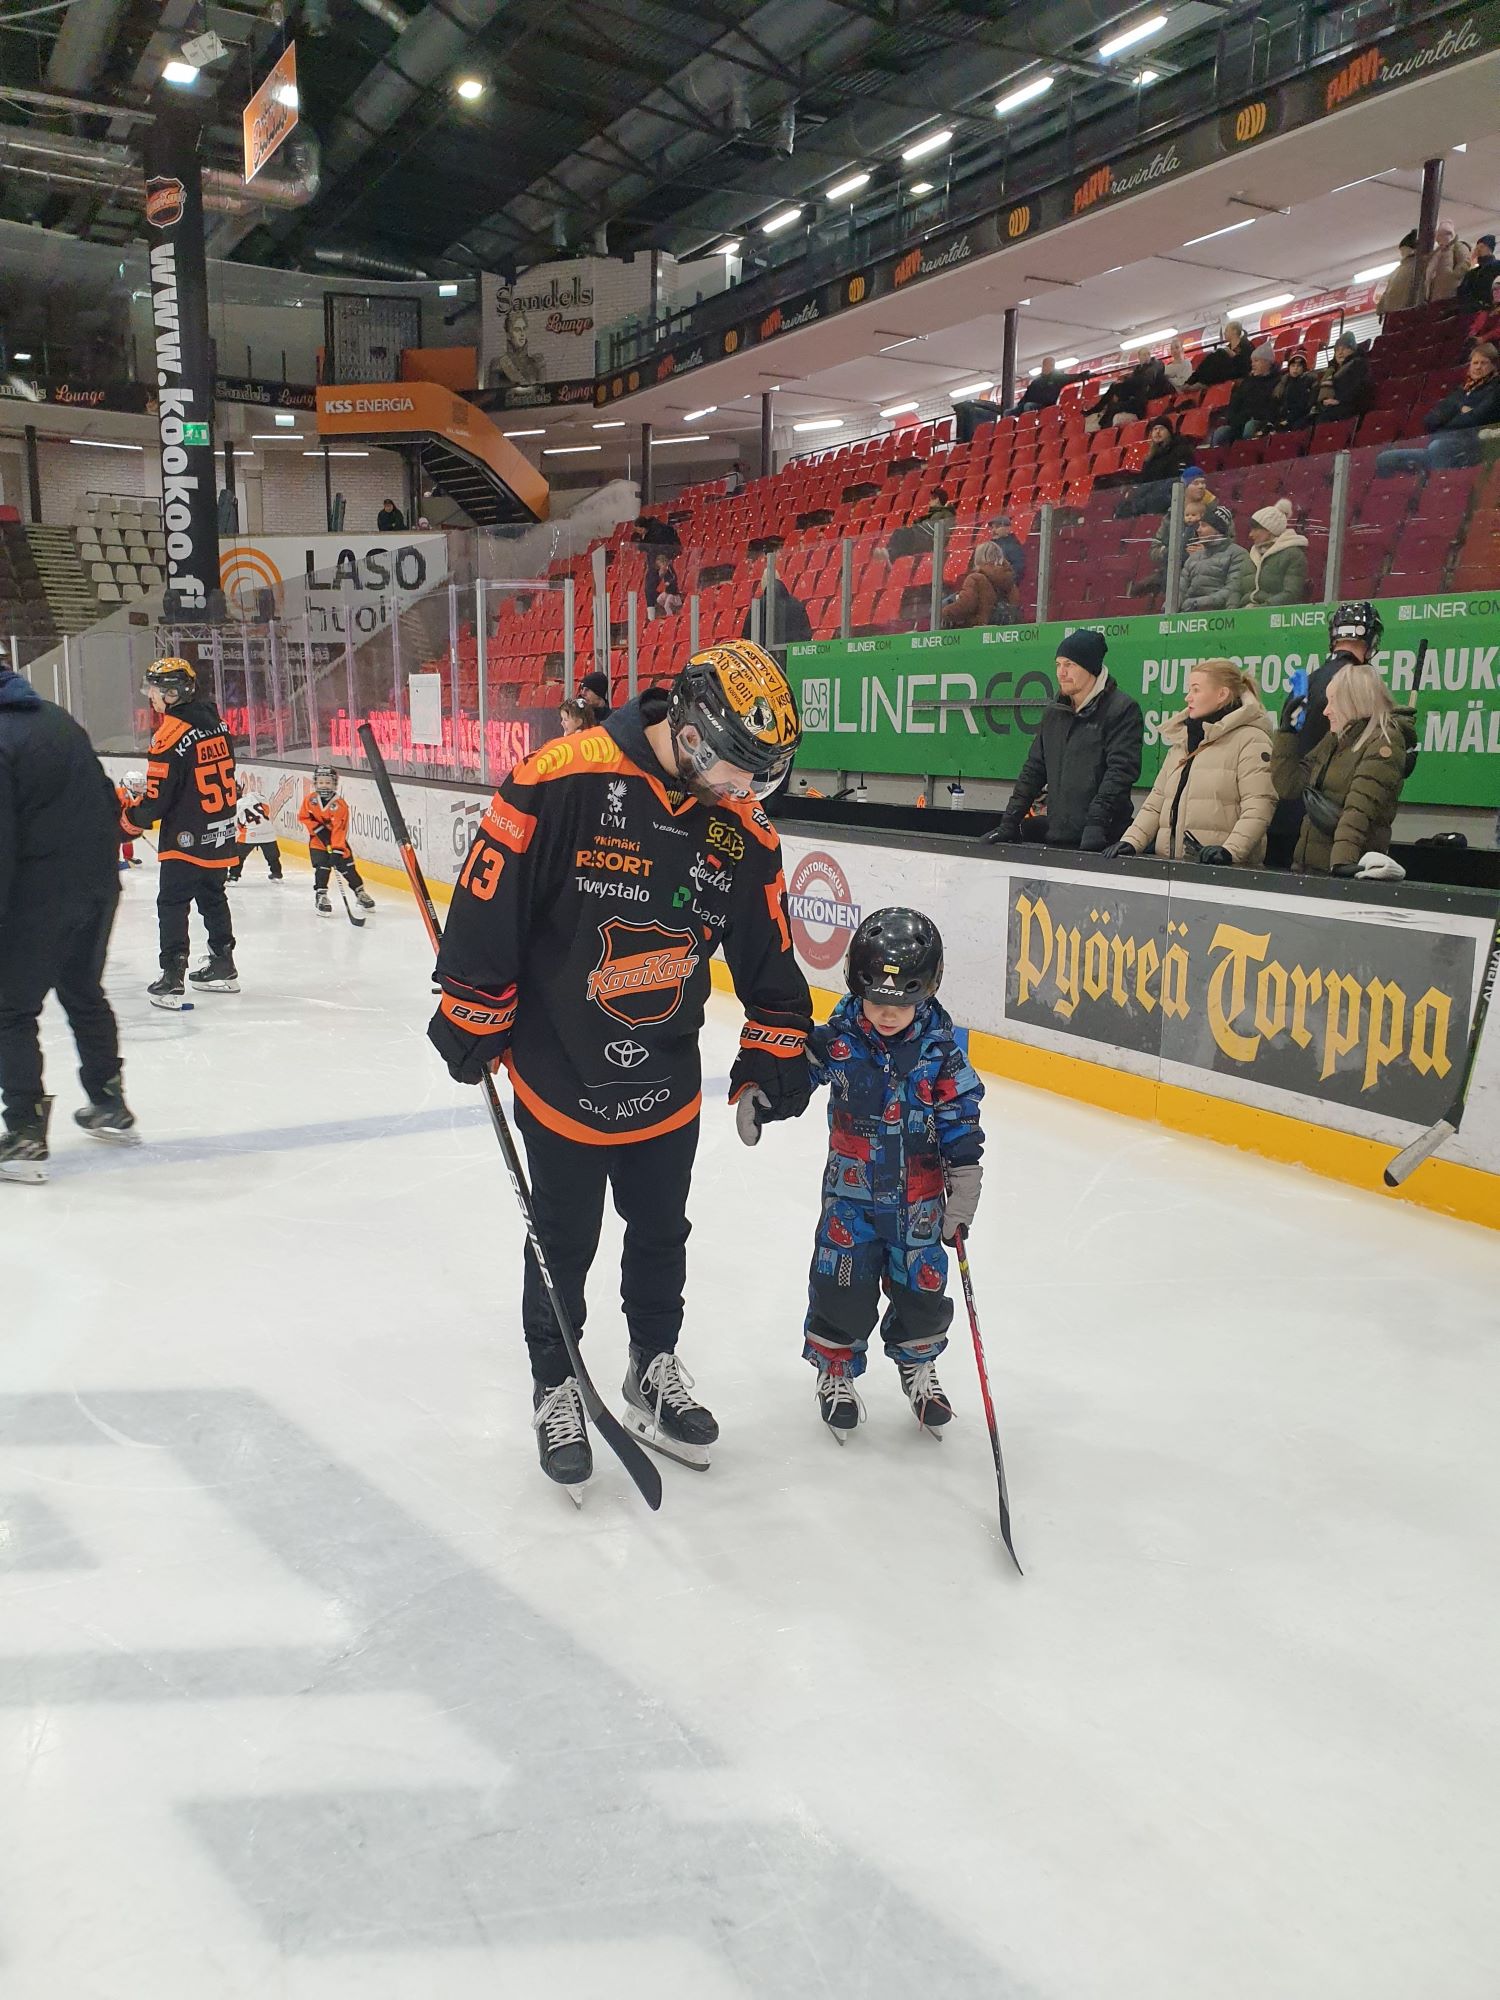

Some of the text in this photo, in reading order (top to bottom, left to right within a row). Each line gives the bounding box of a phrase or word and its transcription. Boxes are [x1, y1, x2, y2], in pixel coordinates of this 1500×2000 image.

[1381, 18, 1482, 83] ravintola
[496, 276, 594, 315] Sandels
[150, 242, 206, 610] www.kookoo.fi
[325, 398, 414, 414] KSS ENERGIA
[304, 546, 427, 591] LASO
[834, 671, 1053, 735] LINERCO
[195, 758, 237, 814] 55
[460, 839, 505, 901] 13
[795, 861, 846, 898] KUNTOKESKUS
[1015, 893, 1453, 1093] Pyöreä Torppa
